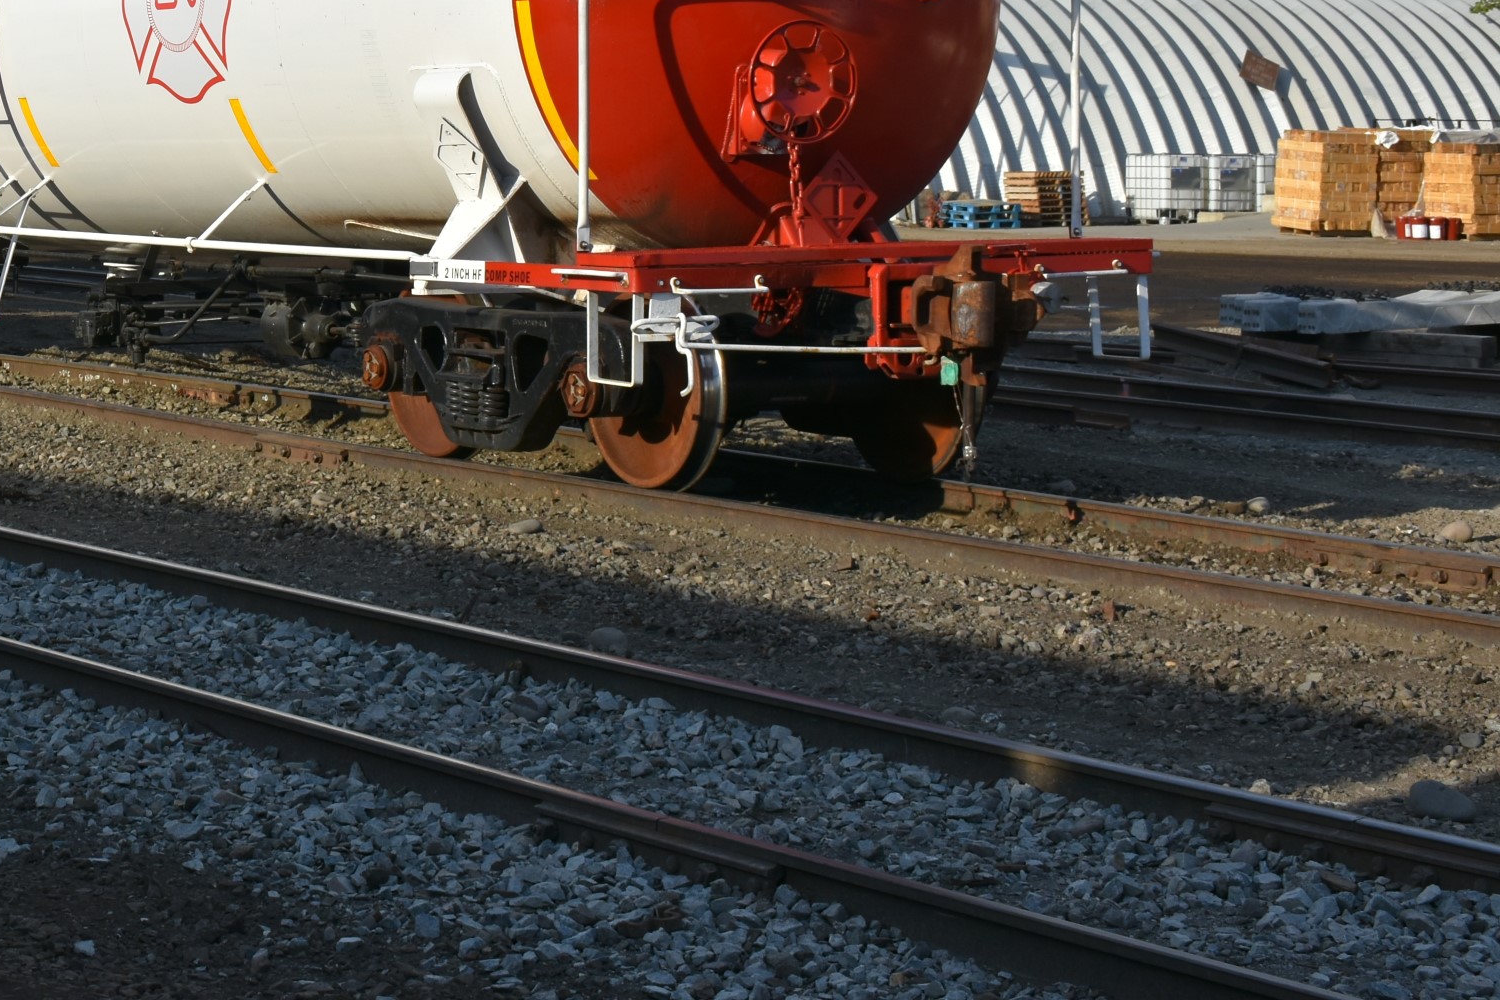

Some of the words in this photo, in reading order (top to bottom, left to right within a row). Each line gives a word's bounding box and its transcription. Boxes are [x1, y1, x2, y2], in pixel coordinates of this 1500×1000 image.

[444, 267, 449, 279] 2
[451, 267, 470, 280] INCH
[472, 269, 482, 281] HF
[485, 270, 507, 282] COMP
[509, 271, 531, 283] SHOE
